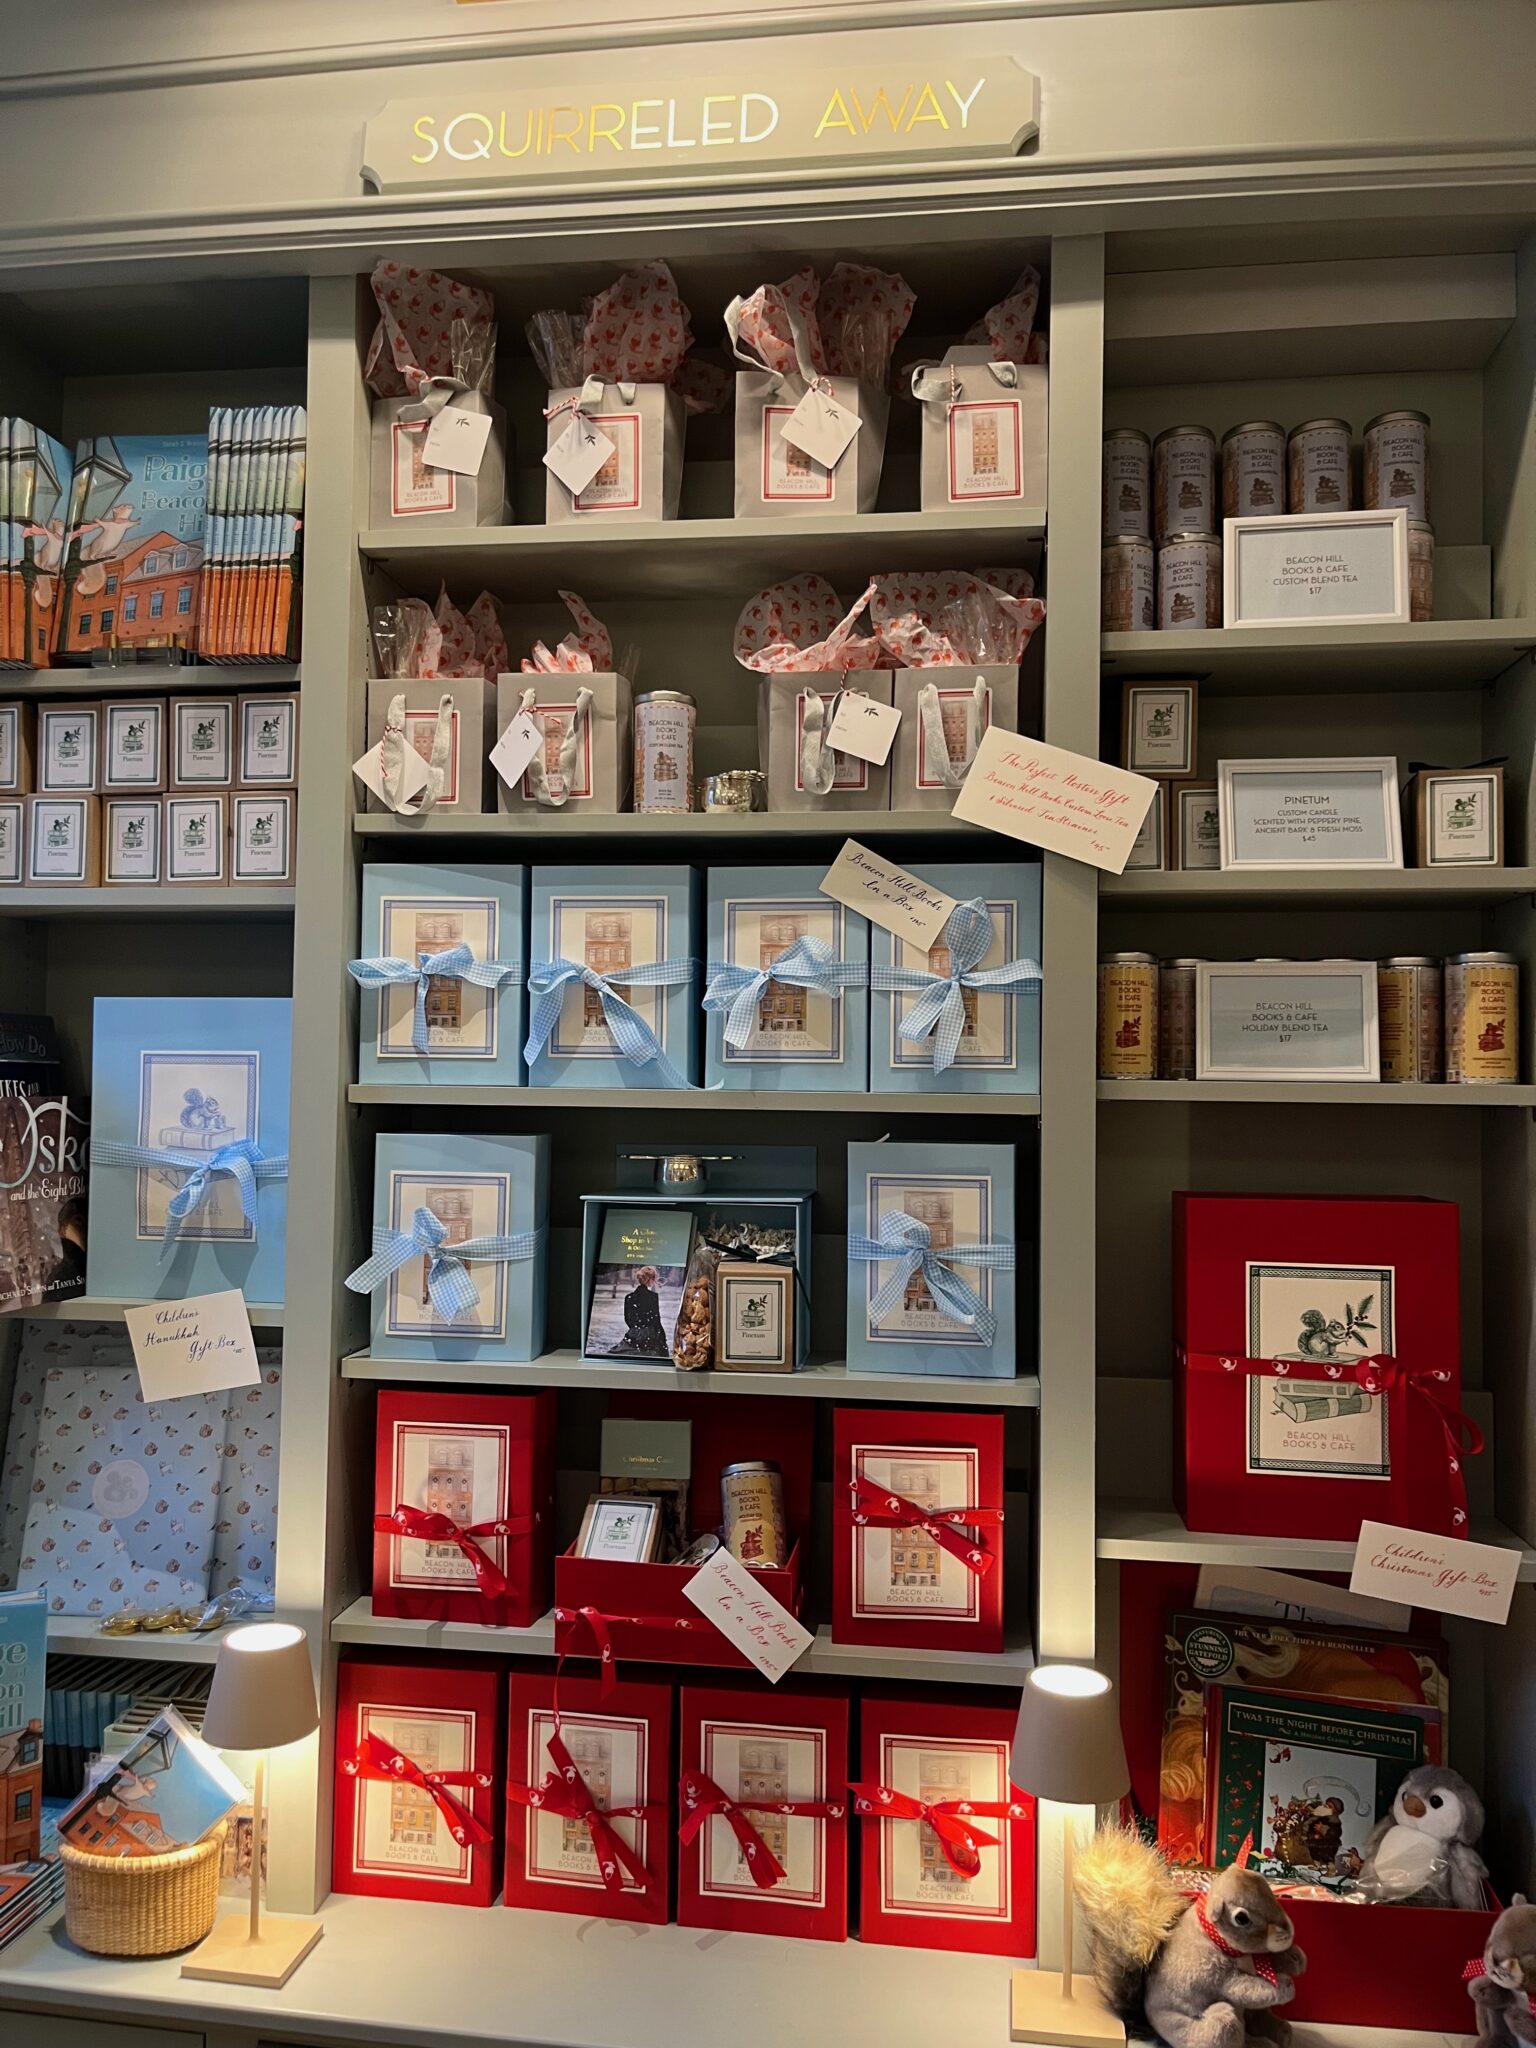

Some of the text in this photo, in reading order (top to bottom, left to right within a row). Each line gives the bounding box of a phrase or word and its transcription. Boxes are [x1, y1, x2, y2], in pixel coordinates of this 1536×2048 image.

[411, 77, 986, 164] SQUIRRELED AWAY
[143, 454, 207, 492] Paig
[140, 490, 206, 512] Beaco
[178, 513, 205, 534] Hi
[1286, 554, 1344, 565] BEACON HILL
[1282, 564, 1349, 575] BOOKS & CAFE
[1272, 574, 1358, 586] CUSTOM BLEND TEA
[1309, 586, 1322, 595] $17
[998, 751, 1131, 808] The Perfect Hostess Gift
[984, 770, 1016, 791] Beacon
[1017, 782, 1041, 796] Hill
[1040, 791, 1063, 805] Books
[1063, 799, 1092, 816] Custom
[1113, 816, 1129, 828] Tea
[1284, 795, 1330, 805] PINETUM
[1036, 808, 1055, 823] Tea
[1277, 808, 1338, 817] CUSTOM CANDLE
[1253, 818, 1286, 826] SCENTED
[1307, 817, 1341, 825] PEPPERY
[1287, 826, 1308, 834] BARK
[1317, 825, 1340, 833] FRESH
[1342, 825, 1363, 833] MOSS
[846, 852, 945, 912] Beacon Hill Books
[862, 880, 881, 894] In
[891, 894, 915, 912] Box
[1255, 1002, 1313, 1010] BEACON HILL
[1251, 1013, 1284, 1021] BOOKS
[1294, 1012, 1318, 1020] CAFE
[1281, 1023, 1310, 1031] BLEND
[1312, 1023, 1329, 1031] TEA
[1279, 1034, 1292, 1043] $17
[29, 1035, 47, 1057] Do
[10, 1184, 27, 1201] and
[27, 1183, 39, 1200] the
[39, 1177, 68, 1202] Eight
[621, 1235, 638, 1246] Shop
[143, 1324, 201, 1348] Hanukkah
[186, 1335, 236, 1364] Gift Box
[1287, 1430, 1352, 1442] BEACON HILL
[1283, 1439, 1356, 1451] BOOKS & CAFE
[424, 1559, 472, 1568] BEACON HILL
[421, 1566, 448, 1574] BOOKS
[455, 1568, 476, 1576] CAFE
[1370, 1554, 1499, 1589] Christmas Gift Box
[889, 1588, 941, 1597] BEACON HILL
[886, 1595, 915, 1603] BOOKS
[710, 1562, 798, 1650] Beacon Hill Books
[716, 1596, 732, 1611] In
[746, 1625, 770, 1647] Box
[1189, 1641, 1229, 1654] STUNNING
[1252, 1631, 1268, 1639] NEW
[1292, 1636, 1315, 1645] TIMES
[1327, 1641, 1376, 1654] BESTSELLER
[1188, 1649, 1228, 1661] GATEFOLD
[1264, 1715, 1285, 1727] THE
[1287, 1719, 1318, 1731] NIGHT
[1321, 1724, 1354, 1738] BEFORE
[1356, 1730, 1412, 1746] CHRISTMAS
[388, 1844, 436, 1855] BEACON HILL
[385, 1851, 412, 1859] BOOKS
[420, 1854, 439, 1863] CAFE
[560, 1853, 592, 1863] BEACON
[558, 1860, 585, 1869] BOOKS
